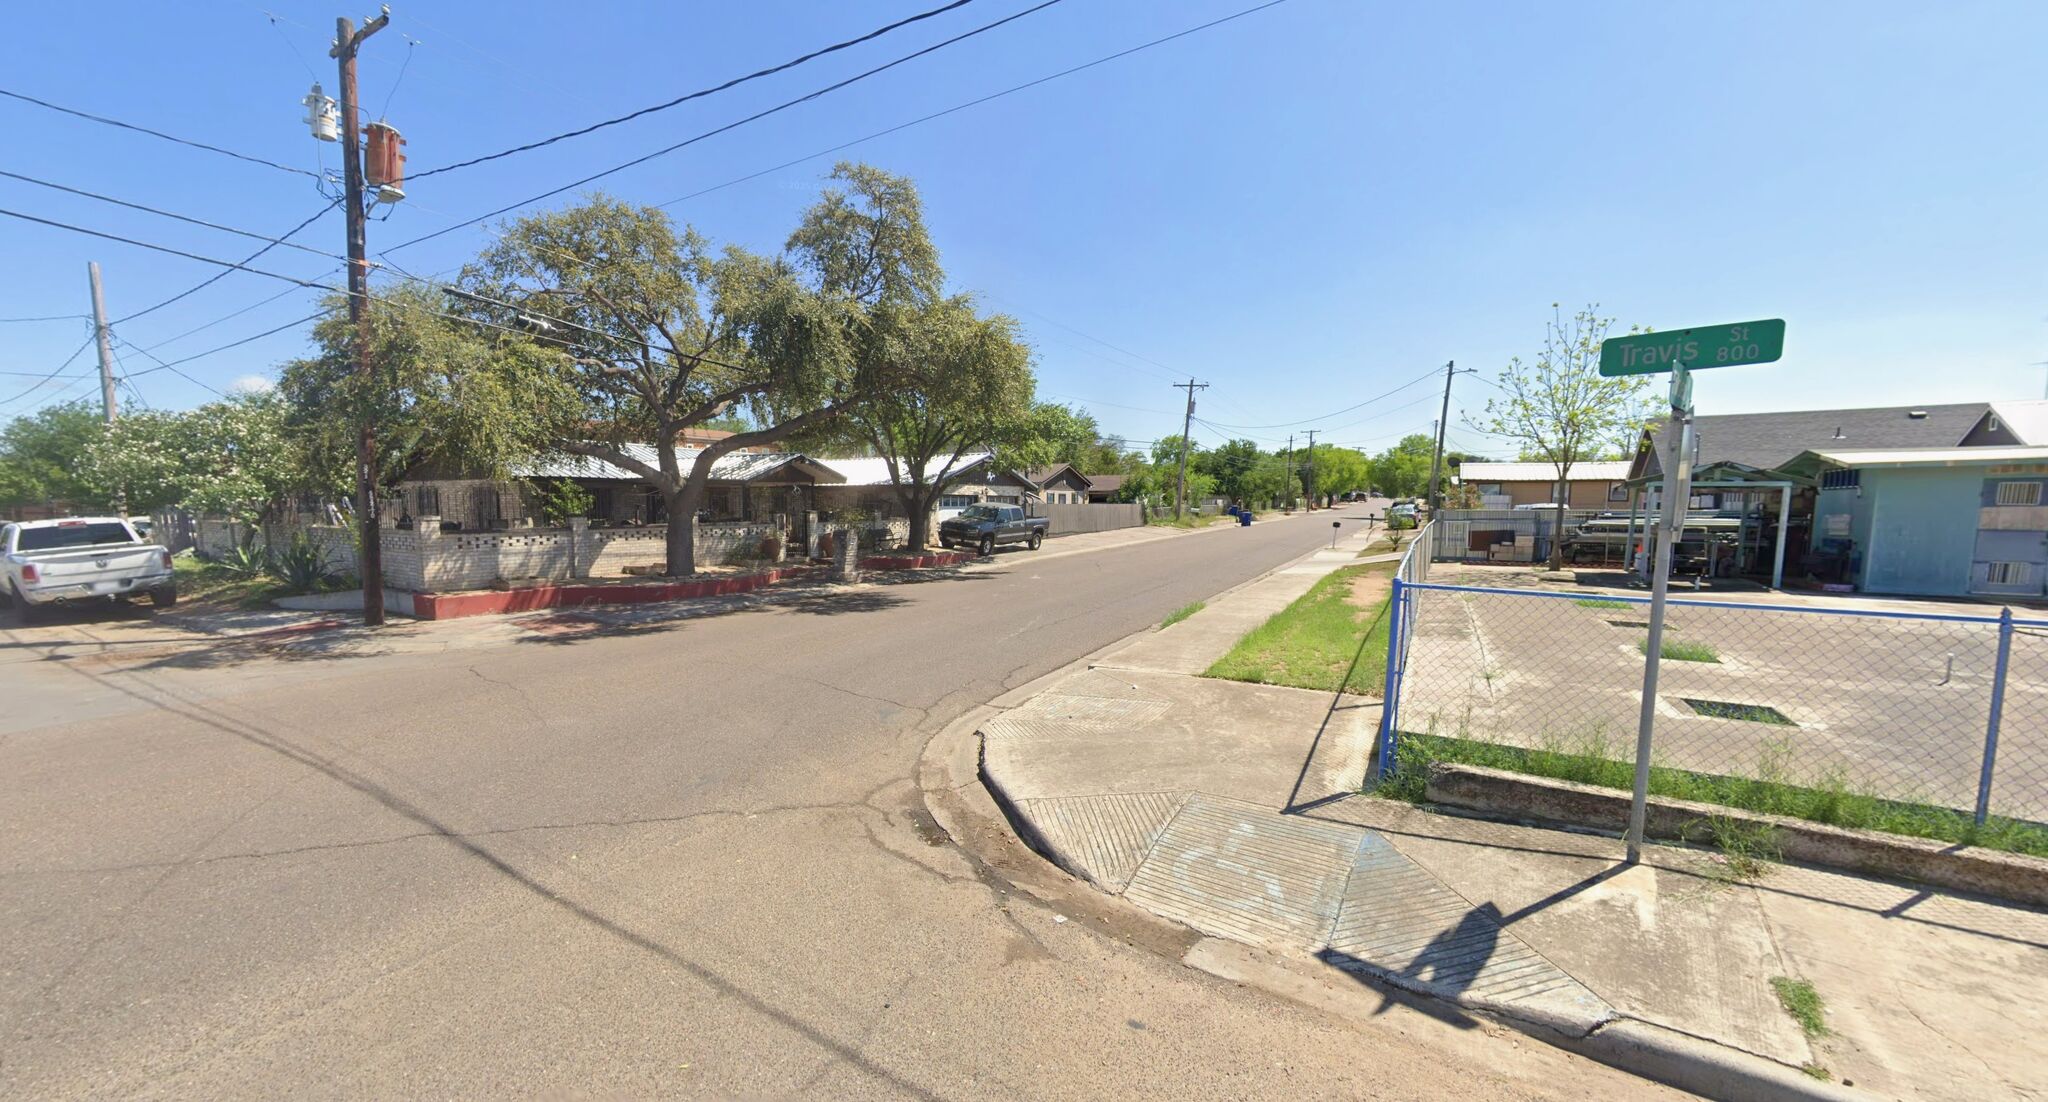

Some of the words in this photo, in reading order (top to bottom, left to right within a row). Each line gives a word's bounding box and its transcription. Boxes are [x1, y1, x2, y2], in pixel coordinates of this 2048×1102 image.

[1729, 326, 1749, 342] St
[1620, 338, 1698, 367] Travis
[1717, 344, 1759, 362] 800
